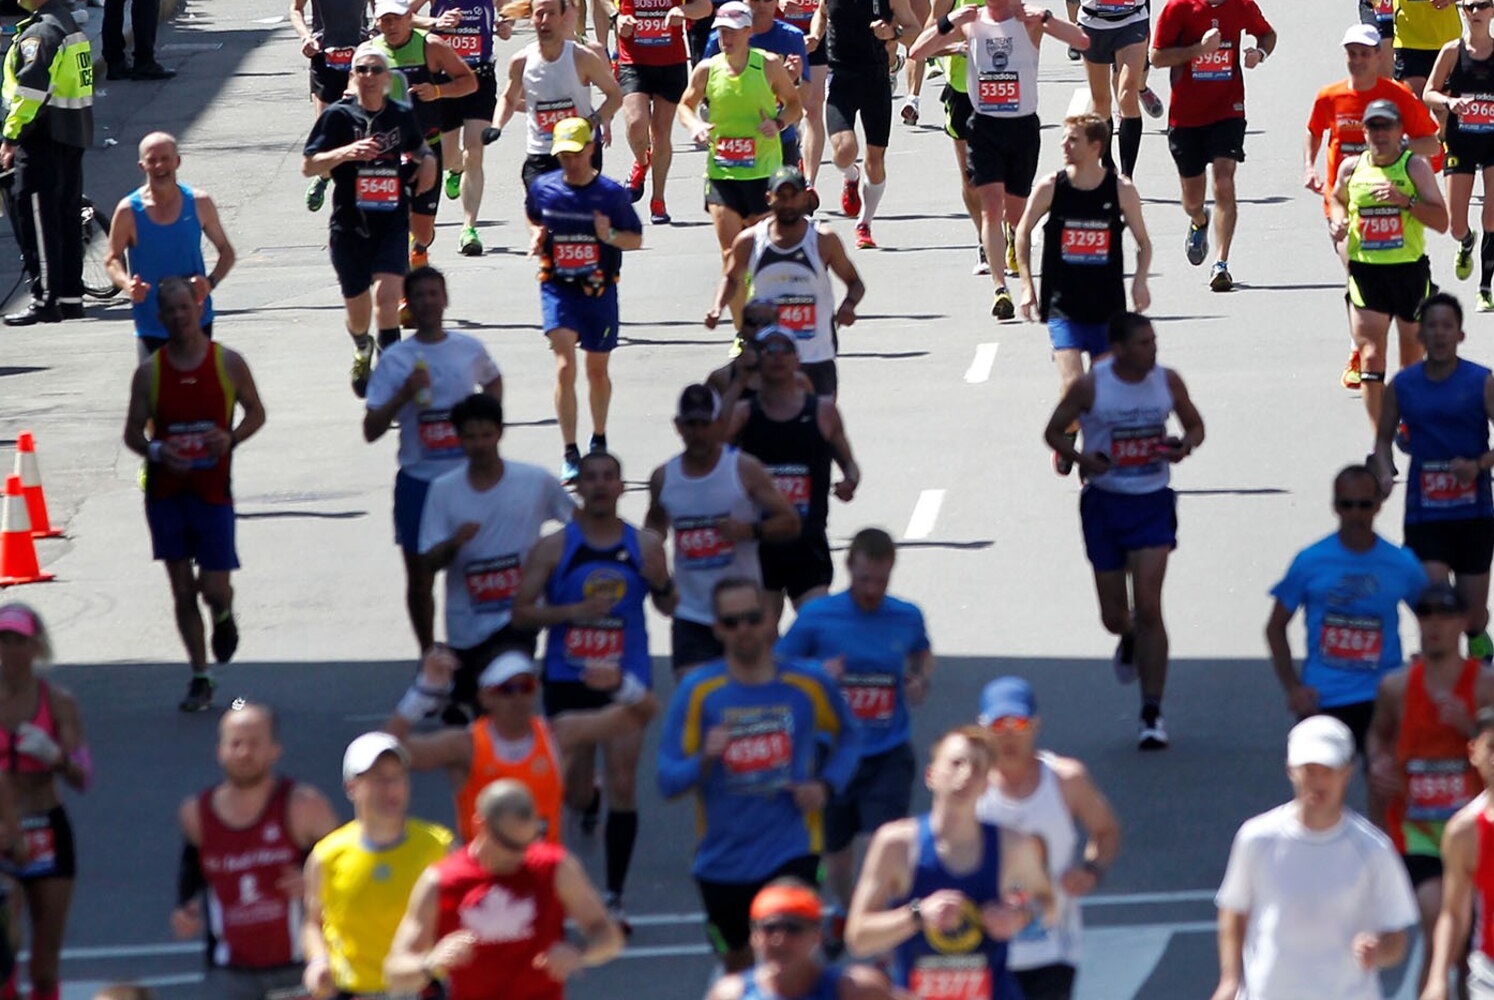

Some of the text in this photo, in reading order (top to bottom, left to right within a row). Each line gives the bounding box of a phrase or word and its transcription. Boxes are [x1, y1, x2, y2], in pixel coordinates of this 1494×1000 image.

[445, 36, 477, 50] 4053
[981, 83, 1015, 97] 5355
[360, 179, 397, 193] 5640
[1363, 218, 1399, 233] 7589
[1066, 231, 1106, 246] 3293
[556, 245, 595, 260] 3568
